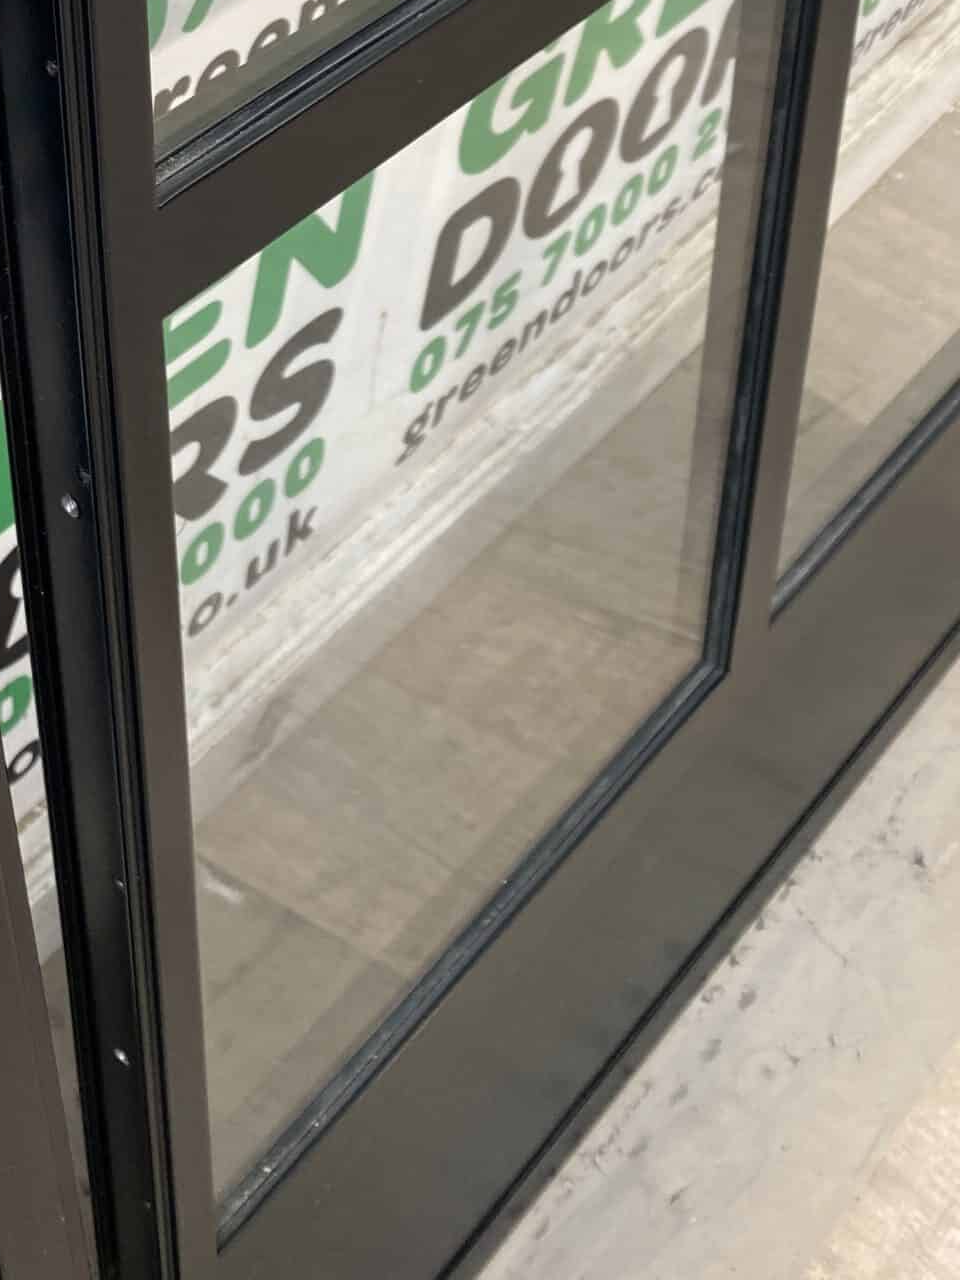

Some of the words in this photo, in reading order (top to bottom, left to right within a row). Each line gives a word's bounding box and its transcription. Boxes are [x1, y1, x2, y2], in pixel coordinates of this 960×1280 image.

[395, 167, 722, 467] greendoors.c
[409, 270, 522, 394] 075
[541, 145, 679, 288] 7000
